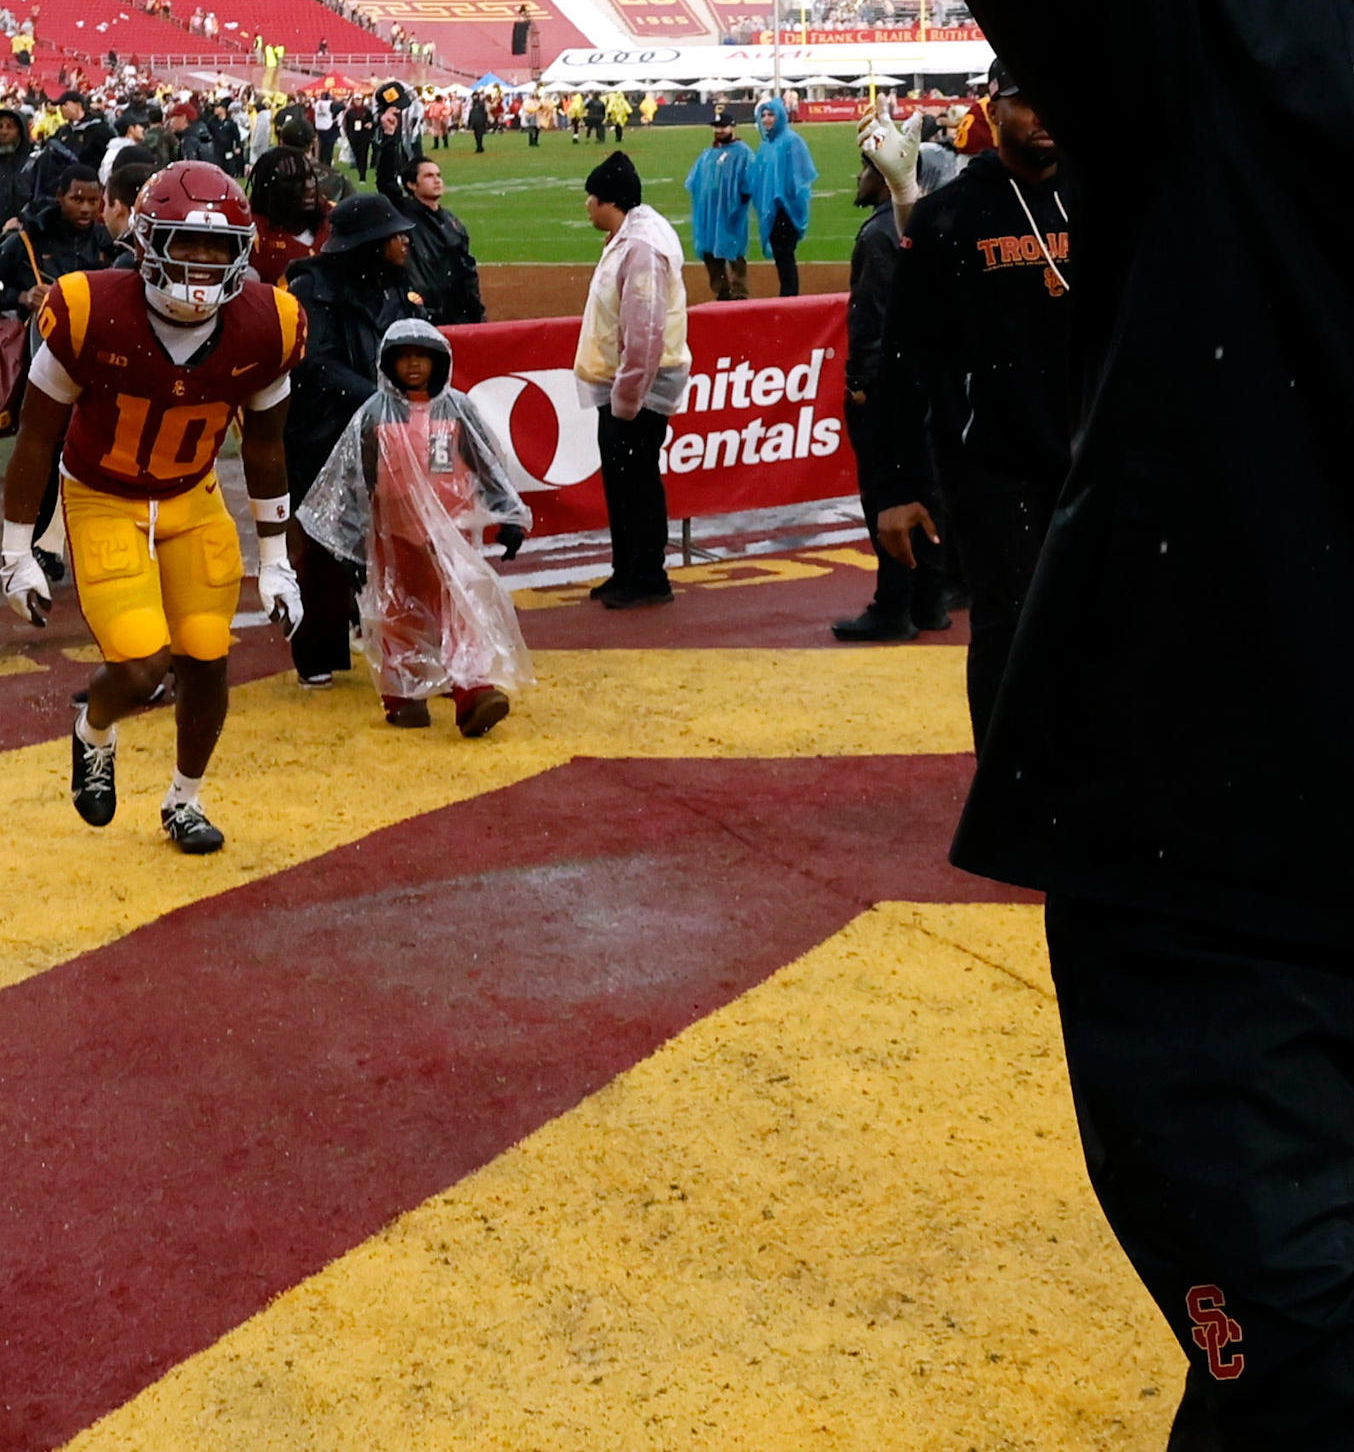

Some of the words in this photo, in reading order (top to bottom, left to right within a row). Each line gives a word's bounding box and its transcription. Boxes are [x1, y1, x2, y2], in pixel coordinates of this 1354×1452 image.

[811, 31, 853, 43] FRANK
[875, 30, 912, 42] BLAIR
[930, 29, 967, 41] RUTH
[677, 348, 824, 414] nited
[100, 392, 231, 480] 10
[1186, 1284, 1244, 1380] SC
